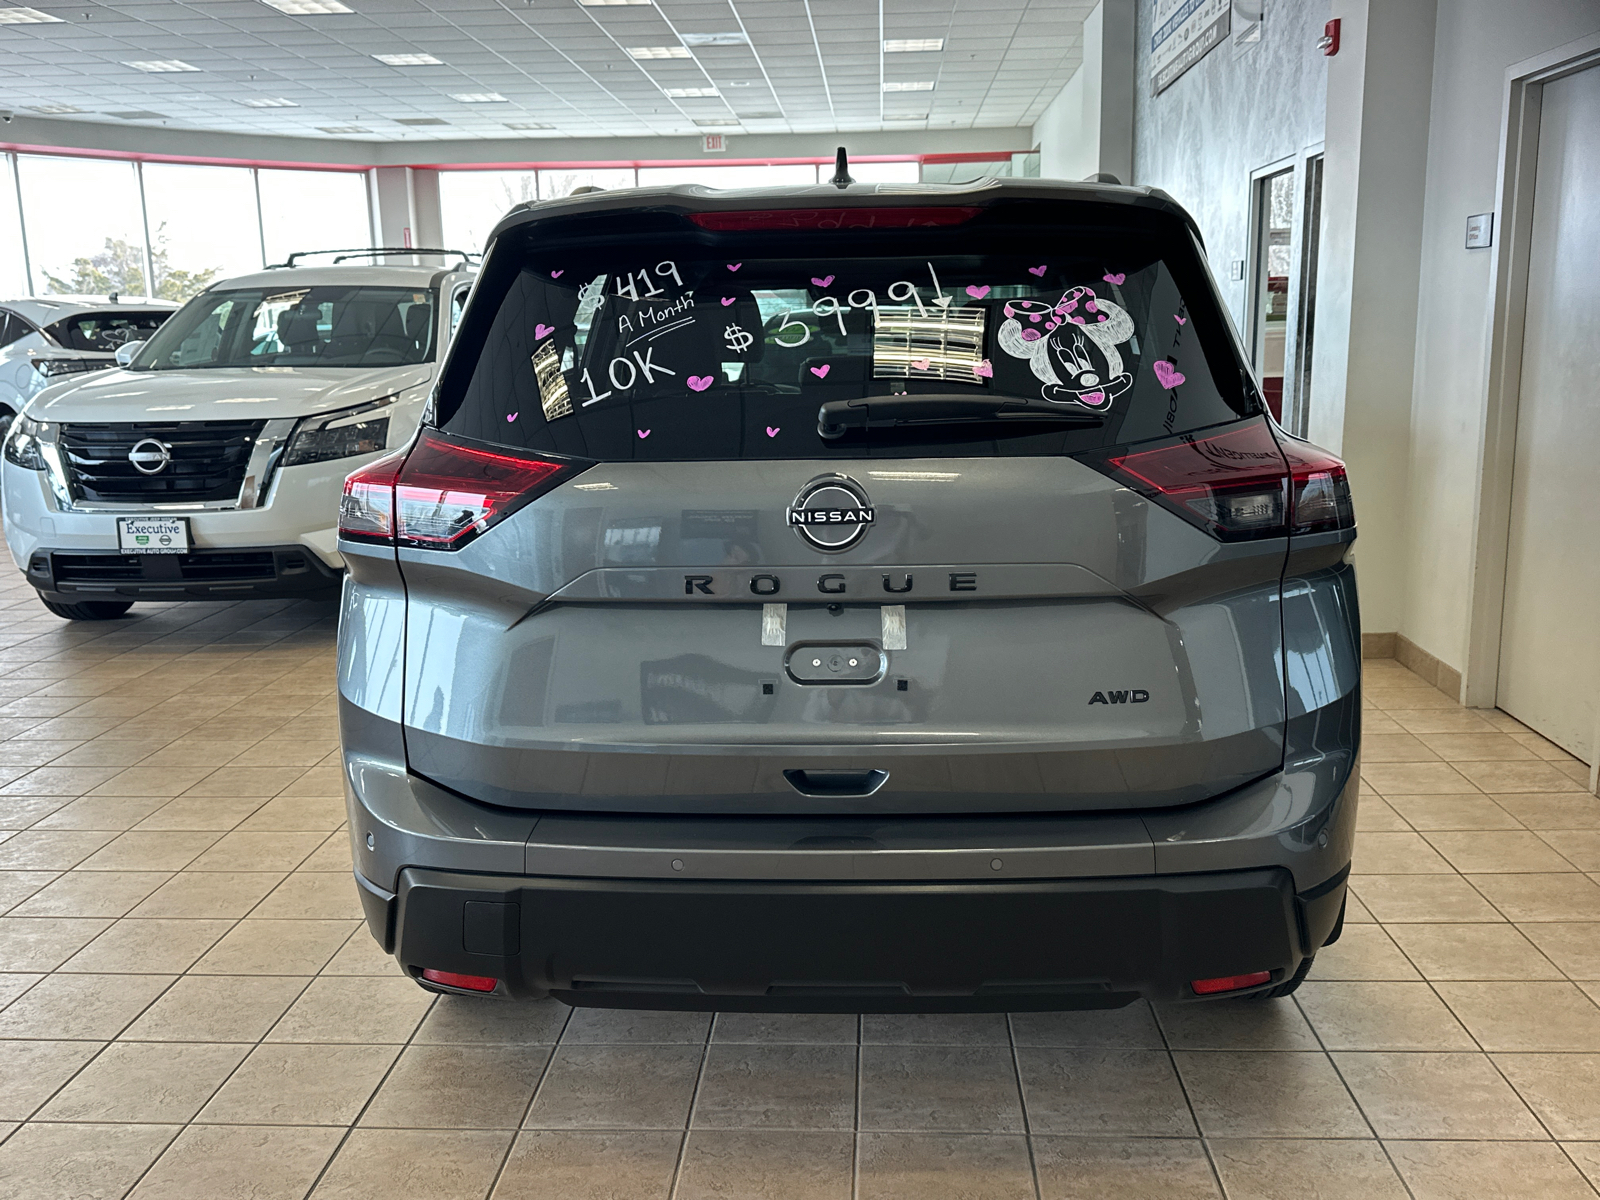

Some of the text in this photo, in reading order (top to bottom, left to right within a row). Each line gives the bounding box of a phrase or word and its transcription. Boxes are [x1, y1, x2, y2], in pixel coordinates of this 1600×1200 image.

[706, 135, 722, 150] EXIT
[618, 314, 634, 334] A
[579, 346, 676, 408] 10K
[791, 510, 873, 523] NISSAN
[126, 523, 180, 534] Executive
[684, 572, 978, 595] ROGUE
[1088, 689, 1150, 705] AWD
